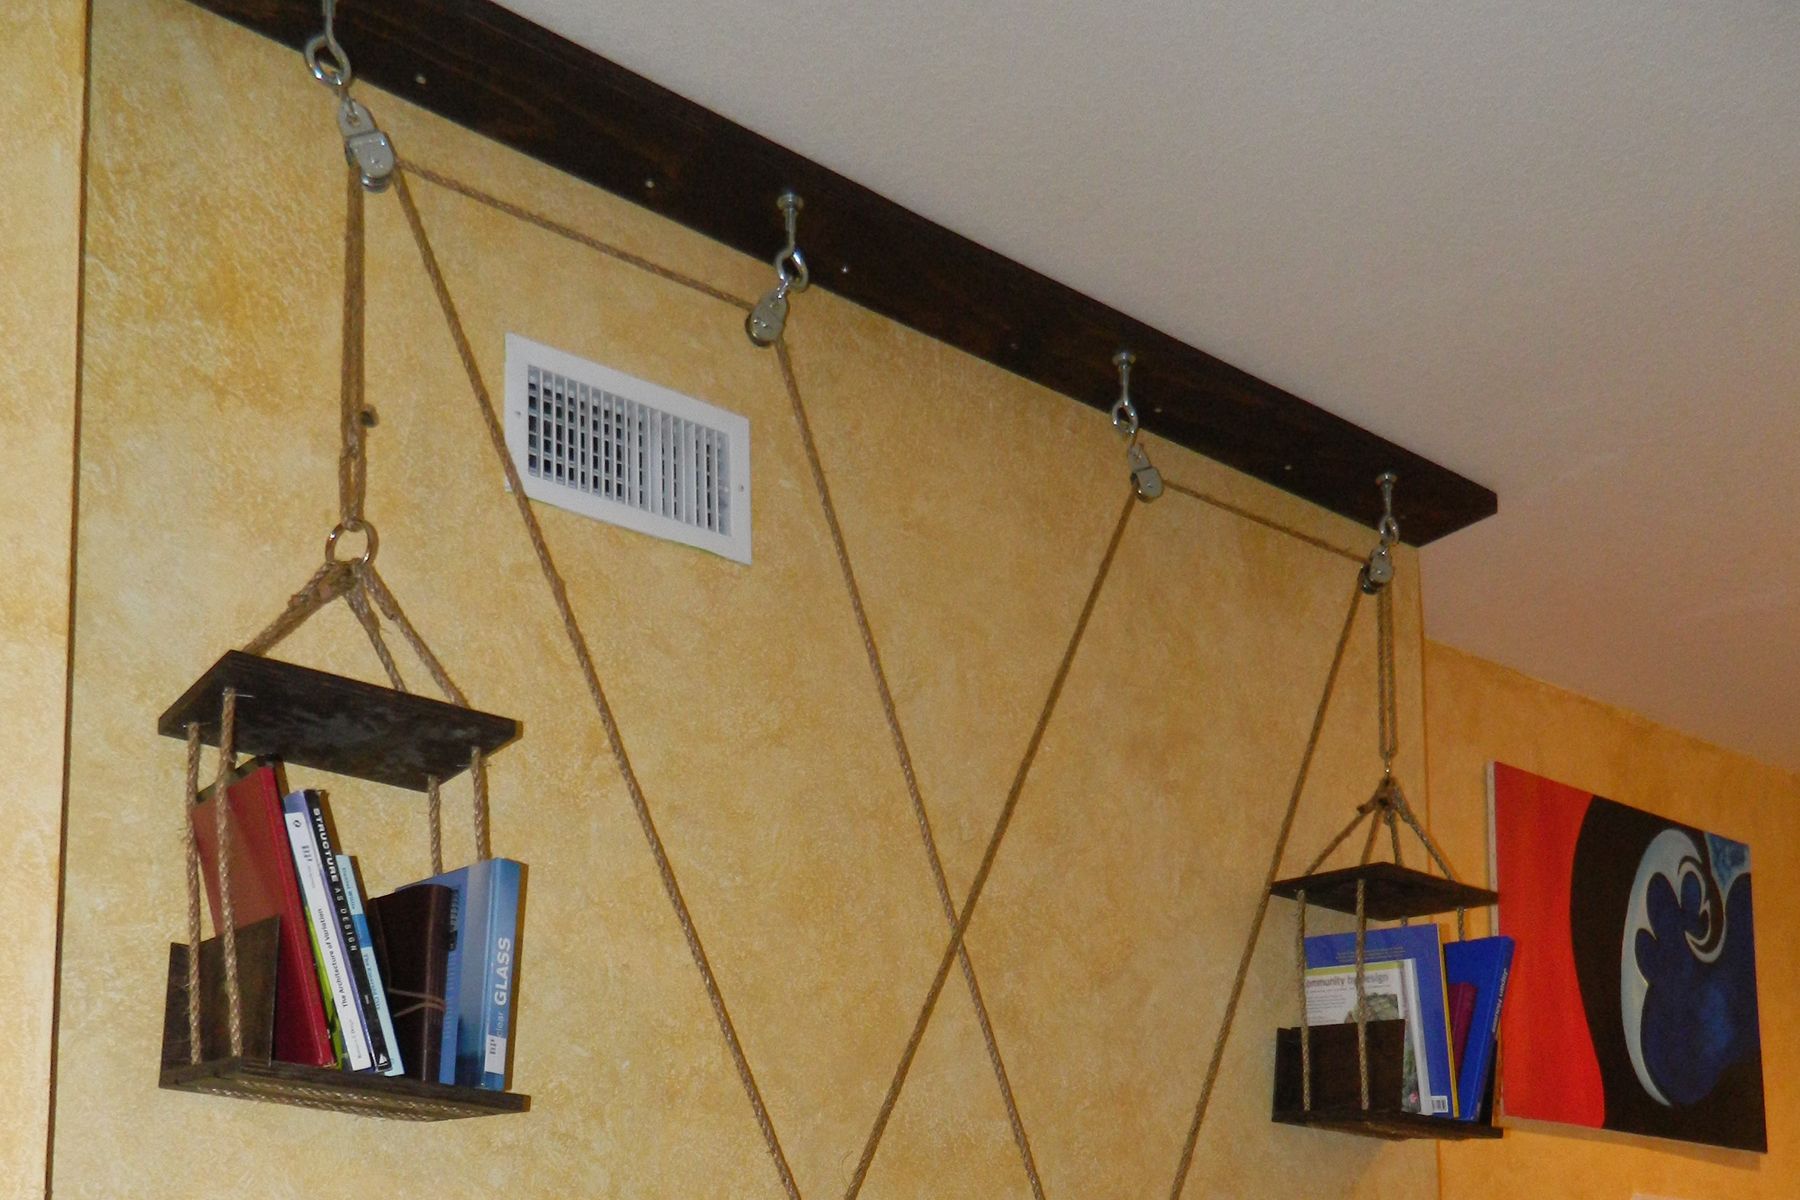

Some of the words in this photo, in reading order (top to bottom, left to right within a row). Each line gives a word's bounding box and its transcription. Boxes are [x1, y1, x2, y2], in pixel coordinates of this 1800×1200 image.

[313, 807, 338, 882] STRUCTURE
[333, 887, 343, 902] AS
[340, 908, 358, 951] DESIGN
[317, 907, 332, 942] Variation
[328, 952, 345, 993] Architecture
[494, 936, 511, 1006] GLASS
[1306, 975, 1345, 988] ommunity
[340, 992, 348, 1007] The
